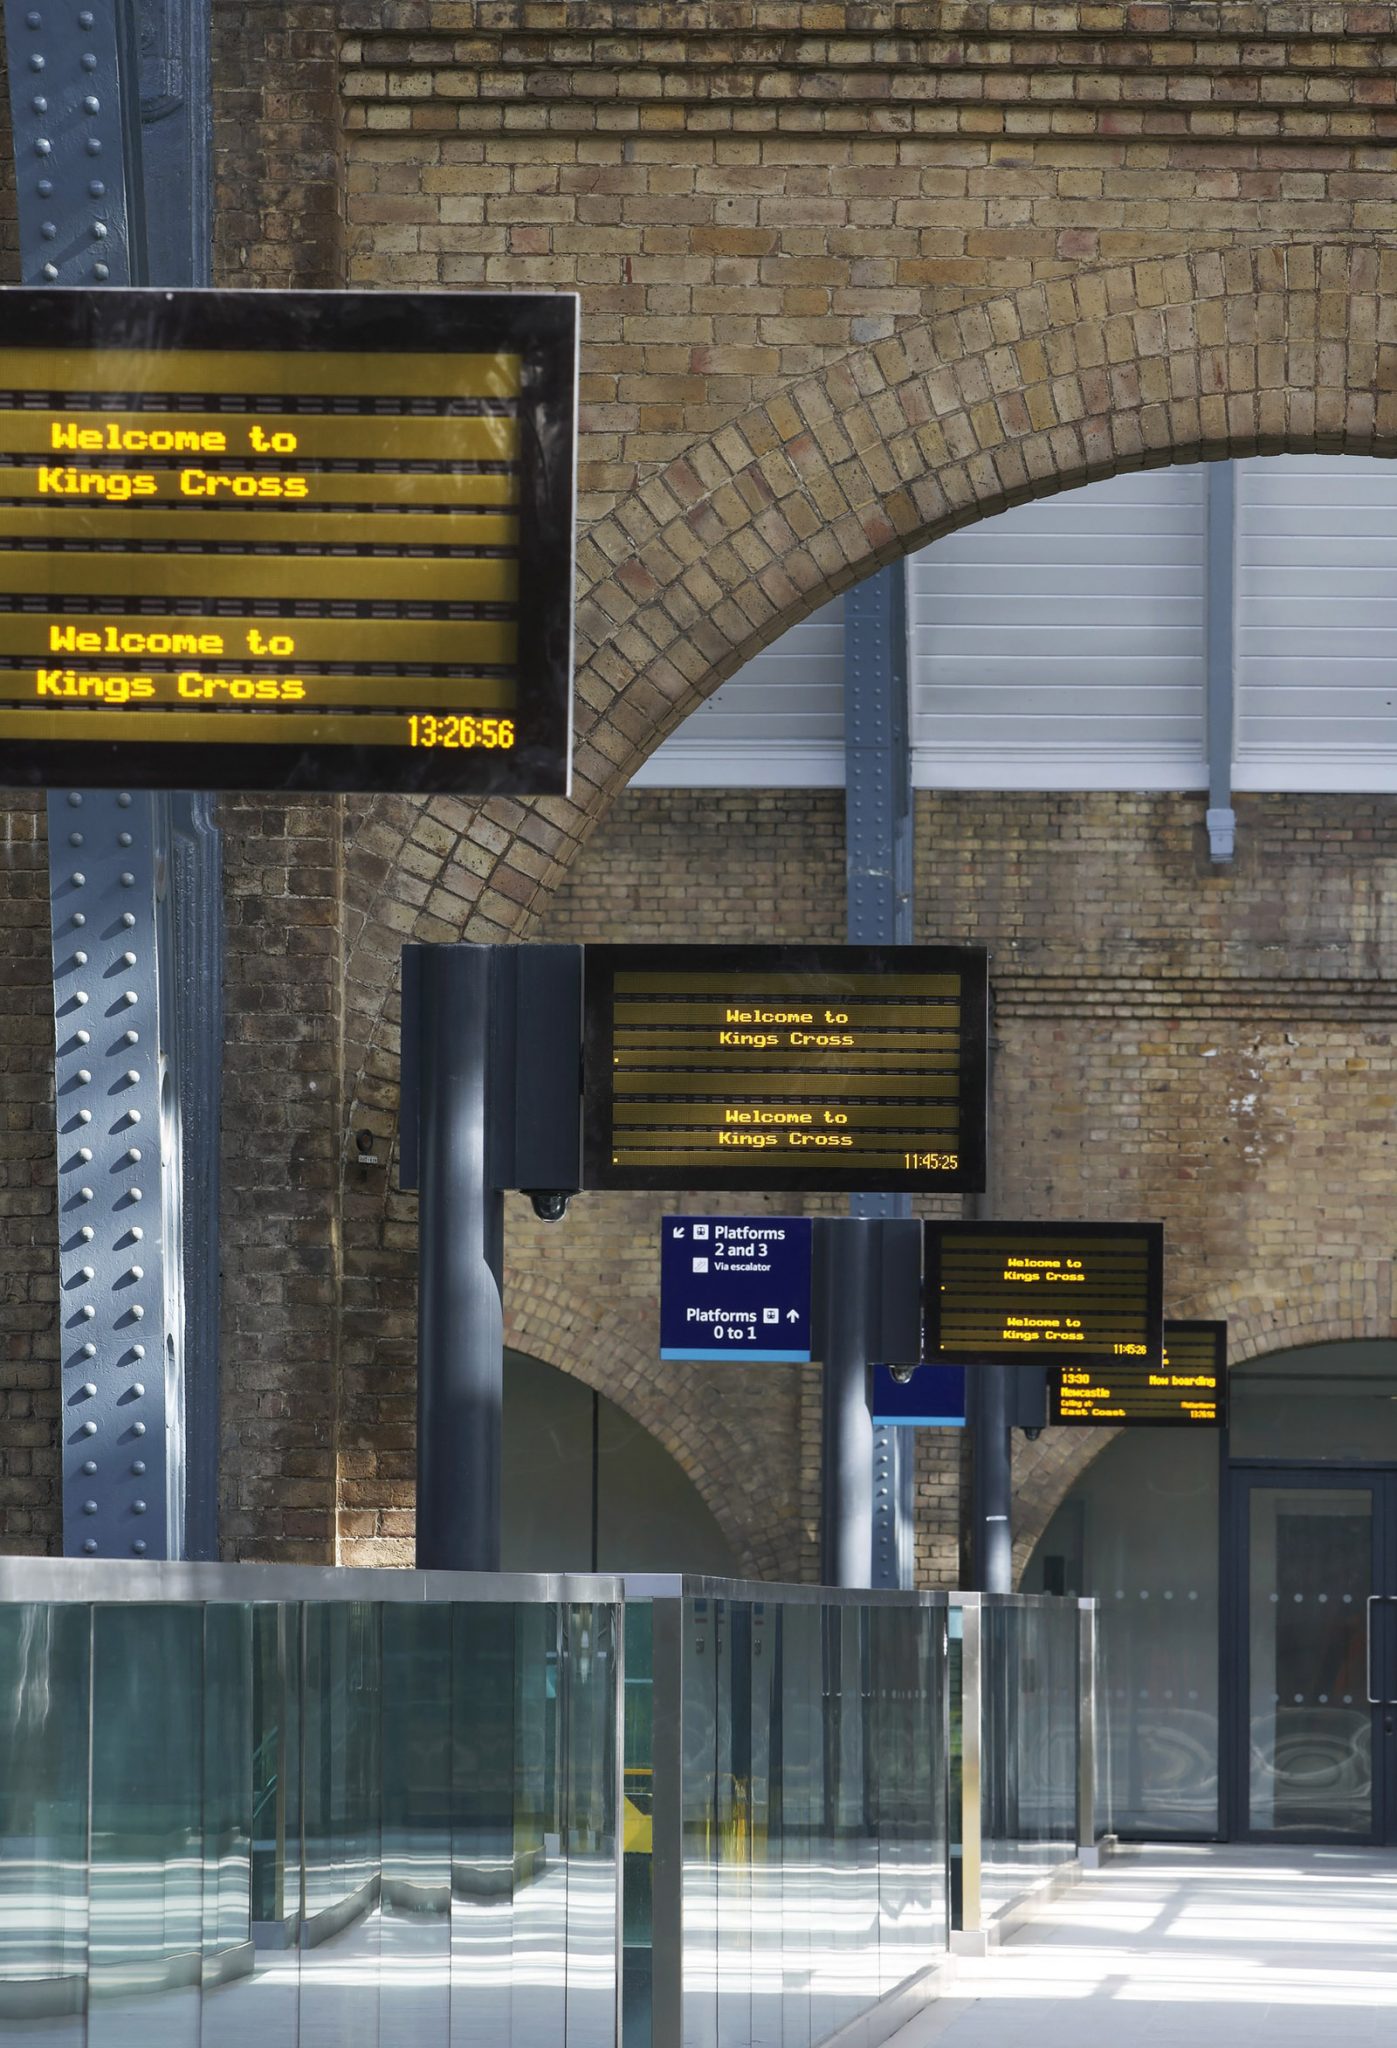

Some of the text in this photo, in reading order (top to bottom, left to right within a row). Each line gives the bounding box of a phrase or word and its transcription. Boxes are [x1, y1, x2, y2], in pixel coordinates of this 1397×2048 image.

[51, 422, 297, 452] Welcome to
[38, 466, 309, 500] Kings Cross
[50, 625, 295, 656] Welcome to
[37, 669, 306, 703] Kings Cross
[408, 715, 514, 748] 13:26:56
[726, 1009, 849, 1024] Welcome to
[719, 1031, 855, 1048] Kings Cross
[725, 1109, 848, 1124] Welcome to
[718, 1131, 854, 1148] Kings Cross
[904, 1153, 958, 1170] 11:45:25
[715, 1225, 786, 1240] Platforms
[714, 1242, 768, 1257] 2 and 3
[714, 1261, 771, 1272] Via escalator
[1007, 1258, 1082, 1269] Welcome to
[1003, 1271, 1085, 1282] Kings Cross
[686, 1307, 757, 1323] Platforms
[1006, 1317, 1081, 1328] Welcome to
[713, 1325, 757, 1340] 0 to 1
[1002, 1330, 1085, 1342] Kings Cross
[1148, 1374, 1216, 1388] Now boarding
[1060, 1386, 1111, 1398] Newcastle
[1060, 1406, 1126, 1417] East Coast
